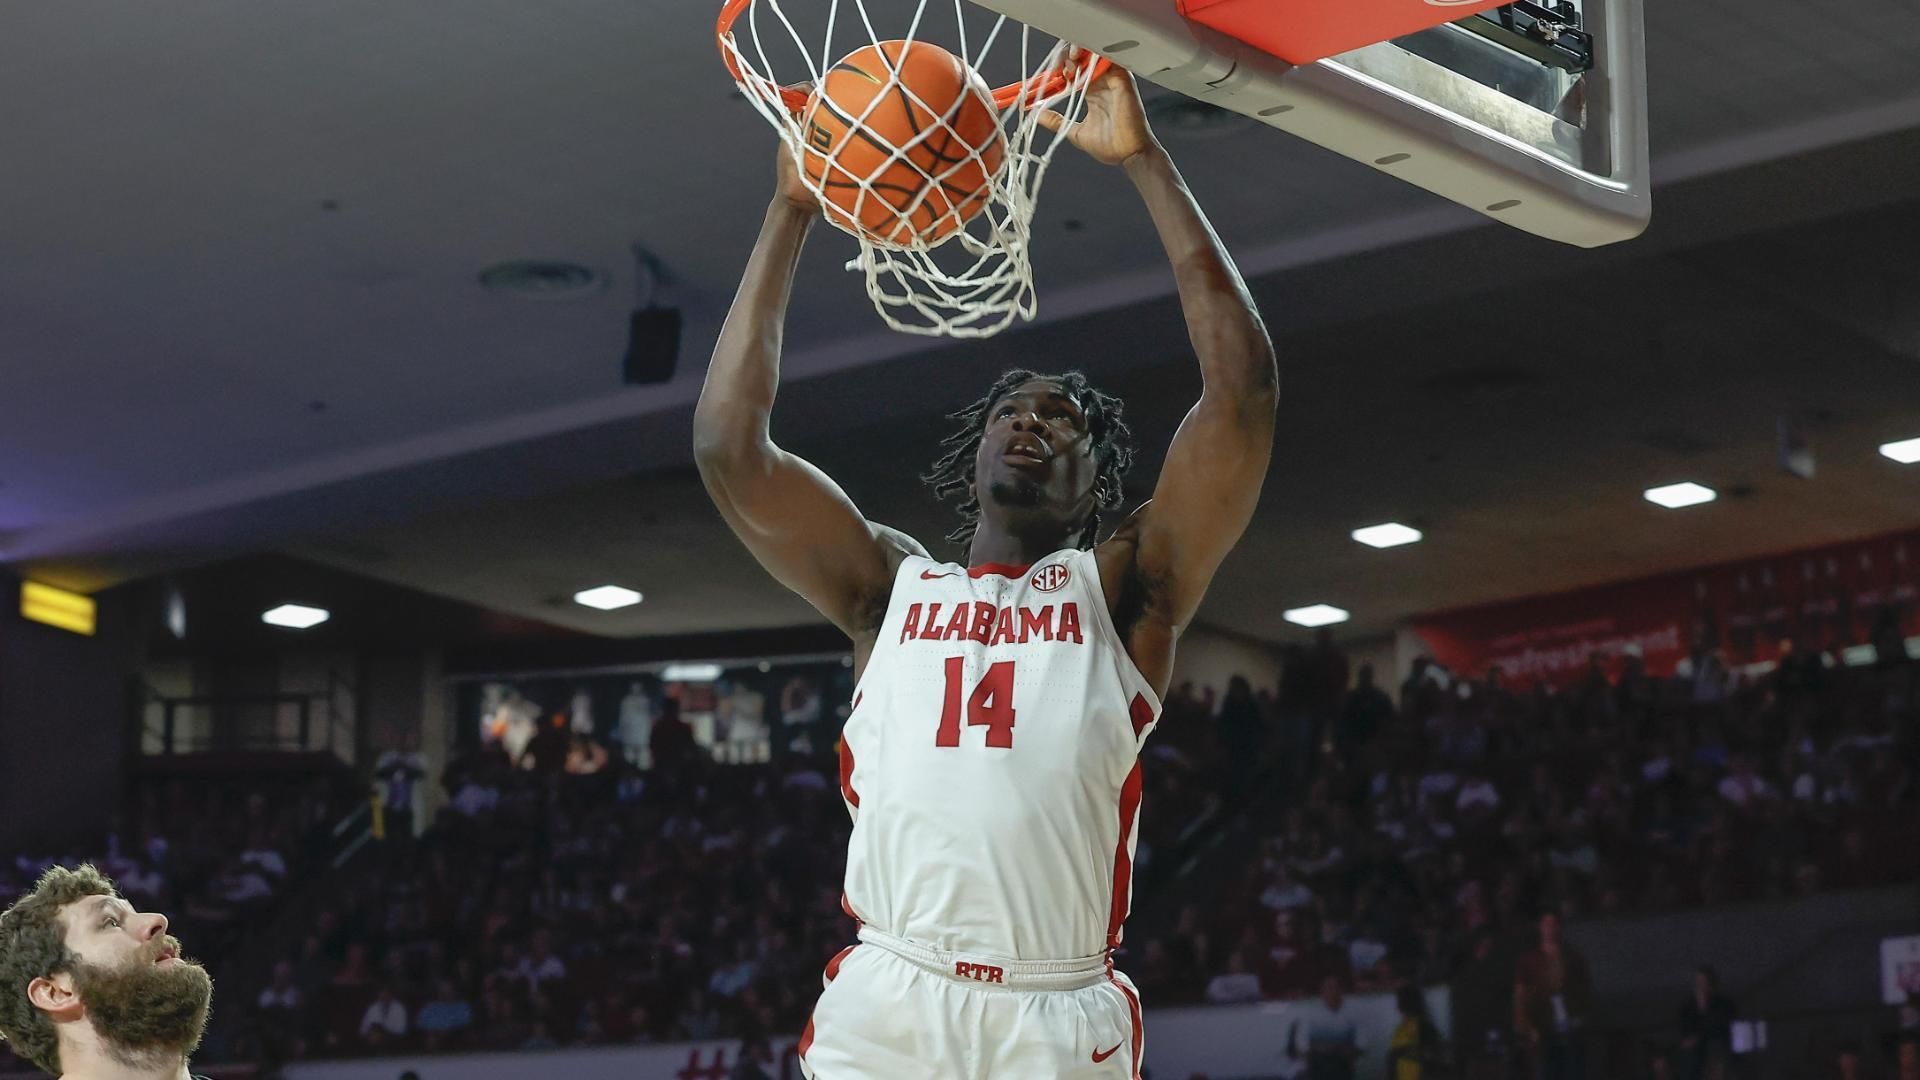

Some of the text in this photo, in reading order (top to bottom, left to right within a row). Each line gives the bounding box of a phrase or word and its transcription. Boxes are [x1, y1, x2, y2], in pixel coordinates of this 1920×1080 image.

[1033, 565, 1068, 591] SEC
[900, 602, 1083, 646] ALABAMA
[936, 656, 1016, 749] 14
[955, 961, 1004, 983] RTR
